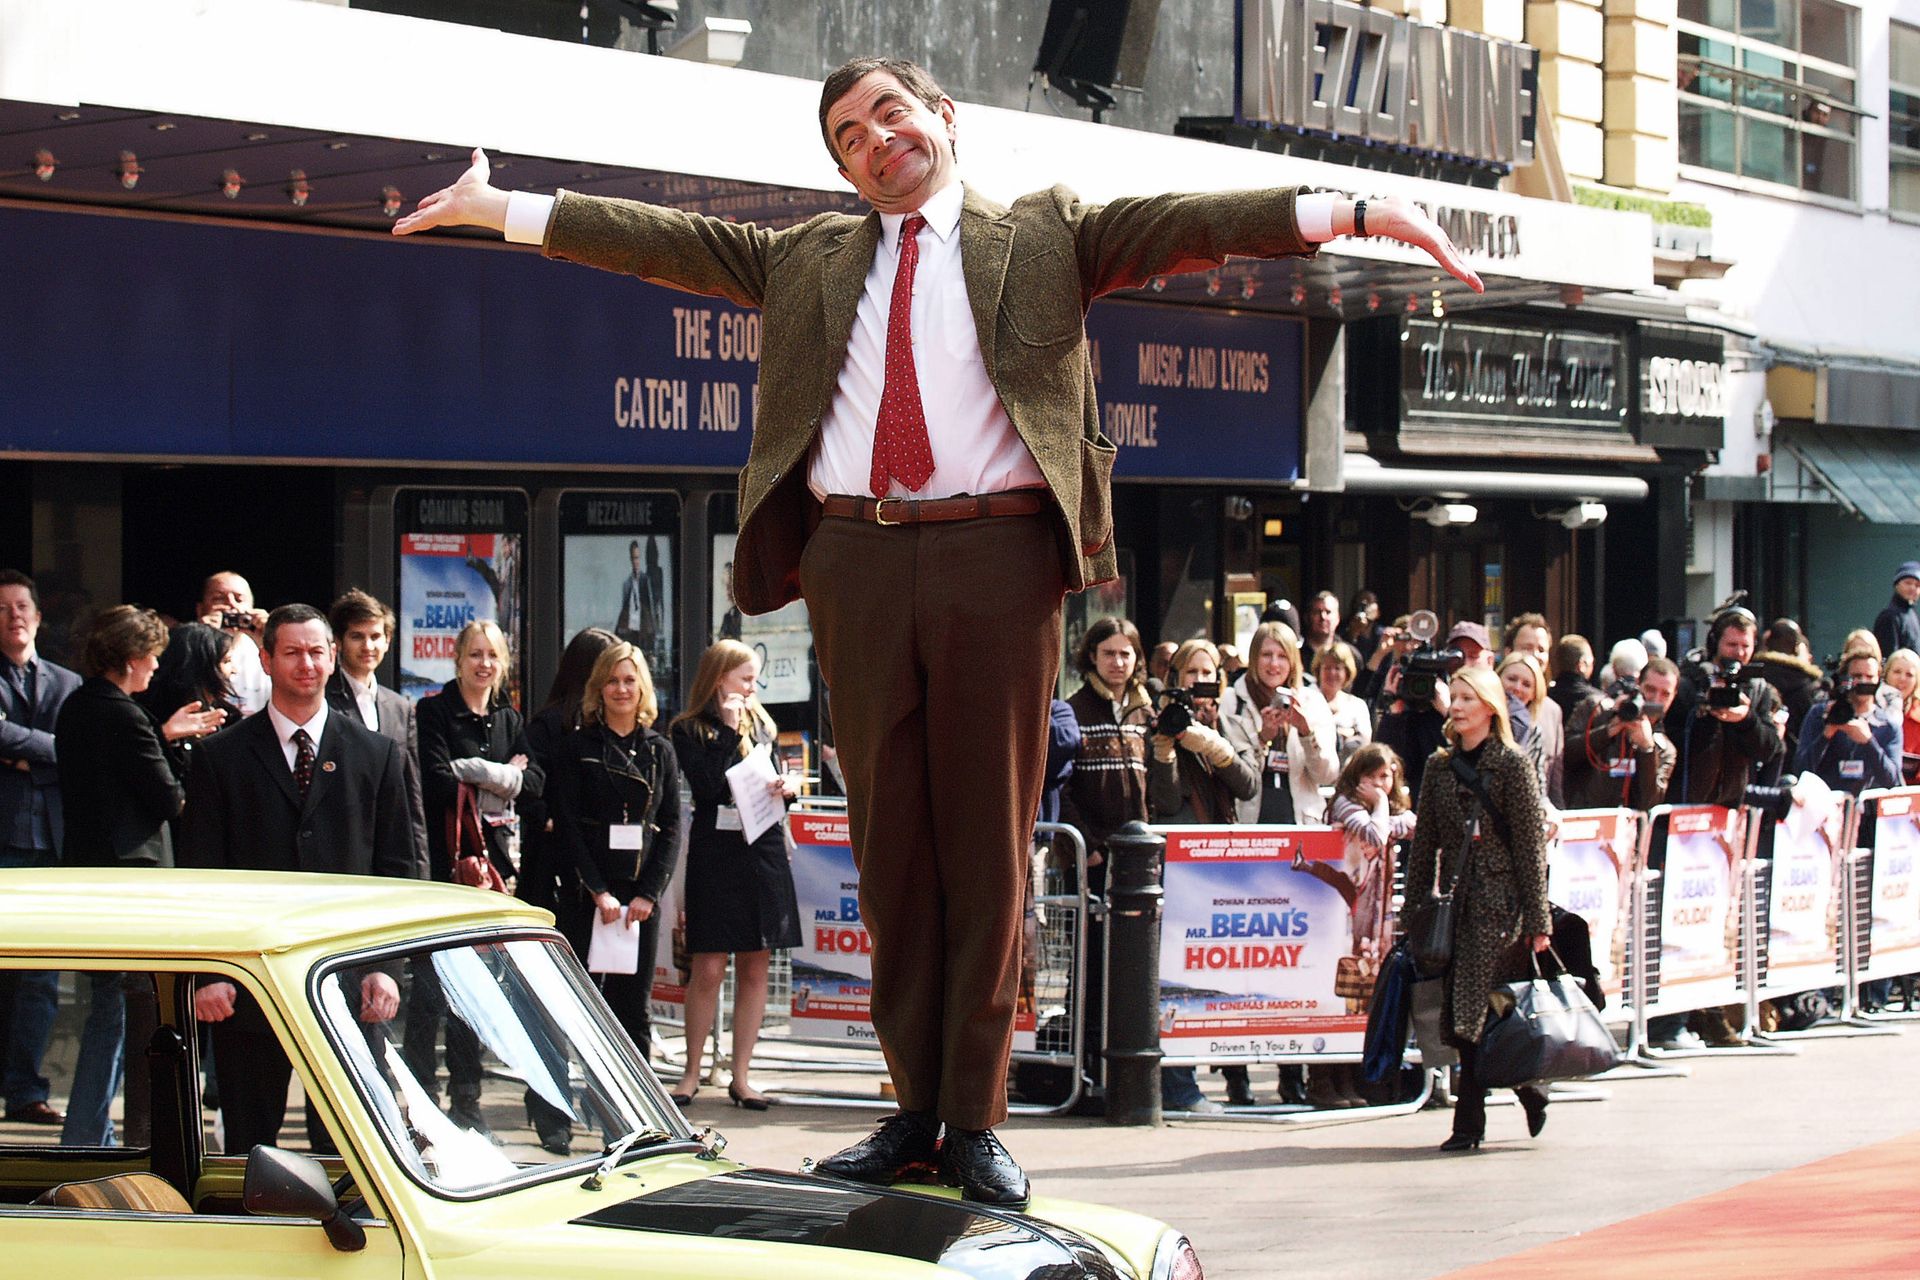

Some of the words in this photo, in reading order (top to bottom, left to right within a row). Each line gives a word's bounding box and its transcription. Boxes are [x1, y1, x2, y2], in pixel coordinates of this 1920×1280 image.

[1241, 0, 1536, 166] MEZZANINE
[672, 306, 712, 360] THE
[718, 312, 761, 363] GOO
[1138, 342, 1183, 388] MUSIC
[1187, 347, 1217, 389] AND
[1220, 348, 1270, 394] LYRICS
[614, 376, 688, 431] CATCH
[698, 381, 741, 432] AND
[1104, 402, 1158, 448] ROYALE
[418, 499, 468, 525] COMING
[471, 499, 505, 525] SOON
[587, 500, 652, 525] MEZZANINE
[413, 636, 457, 659] HOLID
[1213, 898, 1244, 906] ROWAN
[1247, 898, 1290, 906] ATKINSON
[1212, 907, 1309, 939] BEAN'S
[1184, 944, 1304, 972] HOLIDAY
[1206, 1002, 1217, 1011] IN
[1219, 1000, 1265, 1011] CINEMAS
[1266, 1000, 1303, 1010] MARCH
[1305, 1000, 1318, 1010] 30
[847, 1025, 877, 1039] Drive
[1210, 1041, 1246, 1053] Driven
[1250, 1040, 1261, 1051] To
[1265, 1040, 1285, 1051] You
[1289, 1040, 1303, 1053] By
